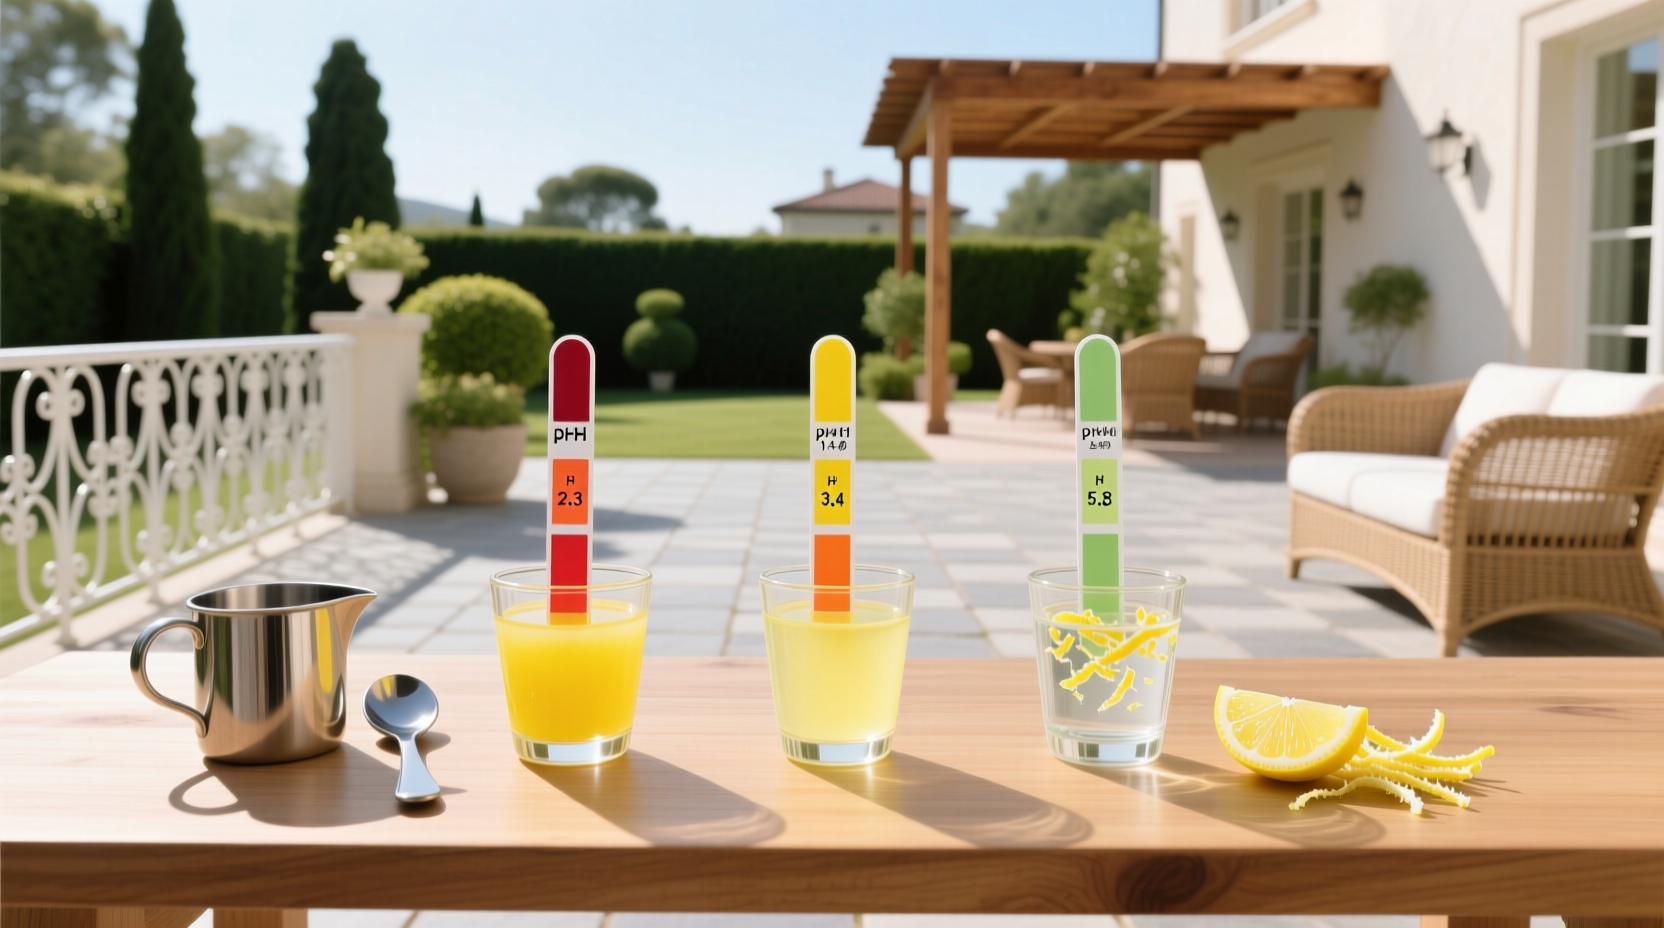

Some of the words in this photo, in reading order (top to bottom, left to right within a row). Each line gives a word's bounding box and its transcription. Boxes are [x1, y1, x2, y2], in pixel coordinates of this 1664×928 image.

[557, 491, 582, 507] 2.3
[821, 491, 845, 507] 3.4
[1088, 491, 1113, 507] 5.8
